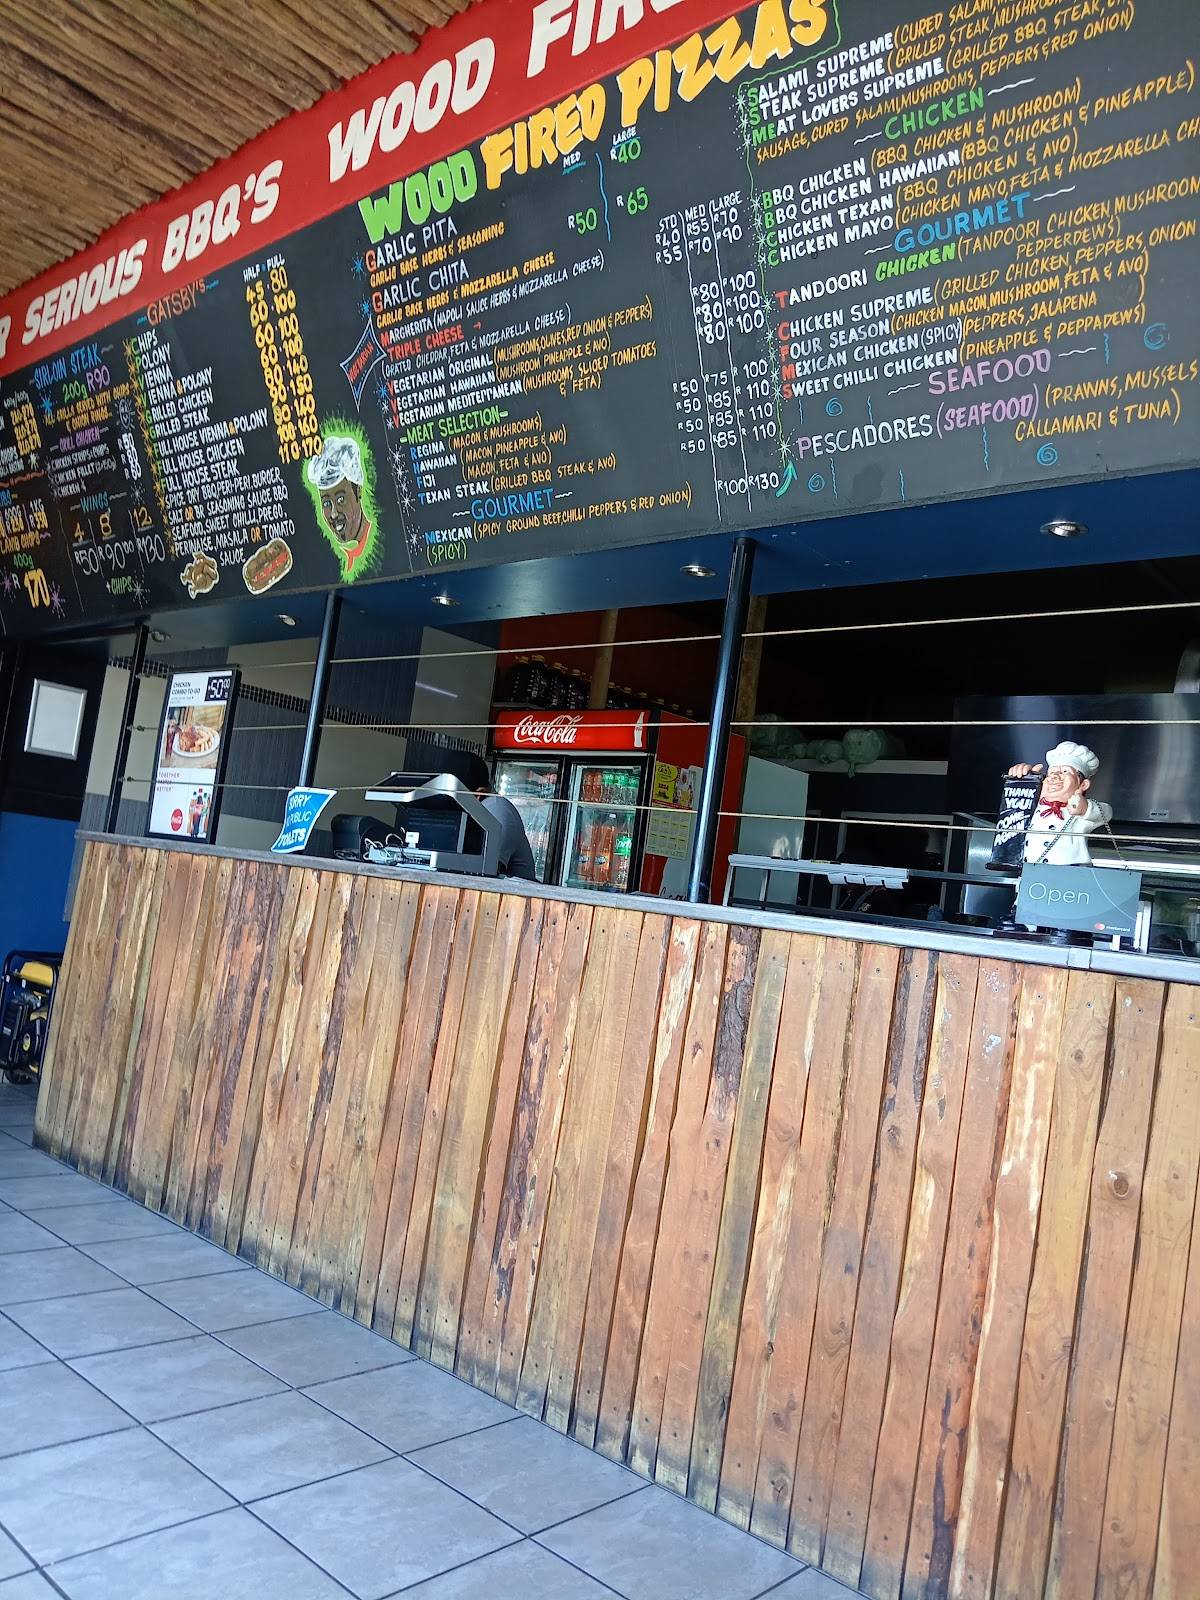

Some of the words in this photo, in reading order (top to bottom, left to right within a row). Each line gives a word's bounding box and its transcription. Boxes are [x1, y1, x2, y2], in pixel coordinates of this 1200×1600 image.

[747, 67, 809, 106] SALAMI
[816, 32, 893, 78] SUPREME
[752, 114, 797, 146] MEAT
[802, 91, 859, 127] LOVERS
[864, 57, 944, 101] SUPREME
[1014, 17, 1047, 43] BBQ
[980, 45, 1038, 80] PEPPERS
[749, 89, 802, 126] STEAK
[807, 57, 886, 103] SUPREME
[358, 149, 478, 245] WOOD
[480, 83, 606, 190] FIRED
[618, 0, 827, 127] PIZZAS
[884, 87, 984, 141] CHICKEN
[563, 151, 581, 168] MED
[612, 126, 637, 145] LARGE
[762, 184, 794, 210] BBQ
[799, 157, 866, 196] CHICKEN
[914, 120, 971, 157] CHICKEN
[991, 76, 1082, 130] MUSHROOM)
[764, 203, 798, 230] BBQ
[801, 177, 872, 215] CHICKEN
[879, 149, 960, 190] HAWAIIAN
[1003, 110, 1073, 149] CHICKEN
[1094, 59, 1195, 118] PINEAPPLE)
[21, 238, 148, 346] SERIOUS
[161, 159, 284, 274] BBQ'S
[326, 37, 495, 184] WOOD
[660, 214, 677, 232] STD
[685, 204, 706, 222] MED
[712, 190, 743, 212] LARGE
[766, 213, 833, 247] CHICKEN
[838, 193, 893, 224] TEXAN
[947, 152, 1017, 188] CHICKEN
[768, 232, 838, 266] CHICKEN
[844, 214, 893, 244] MAYO
[1069, 129, 1171, 173] MOZZARELLA
[567, 207, 598, 234] R50
[686, 218, 709, 237] R55
[894, 191, 1030, 253] GOURMET
[365, 232, 416, 272] GARLIC
[422, 216, 458, 247] PITA
[370, 266, 397, 288] GARLIC
[400, 257, 419, 277] BASE
[457, 221, 505, 253] SEASONING
[688, 236, 712, 255] R70
[243, 263, 261, 283] HALF
[372, 277, 422, 313] GARLIC
[428, 258, 469, 291] CHITA
[377, 314, 403, 329] GARLIC
[405, 302, 424, 317] BASE
[426, 295, 449, 313] HERBS
[461, 266, 519, 299] MOZZARELLA
[523, 251, 555, 276] CHEESE
[692, 282, 719, 302] R80
[775, 268, 868, 308] TANDOORI
[875, 242, 956, 281] CHICKEN
[777, 309, 844, 341] CHICKEN
[851, 286, 933, 323] SUPREME
[1149, 219, 1196, 247] ONION
[147, 278, 206, 326] GATSBY'S
[379, 319, 433, 348] MARGHERITA
[466, 297, 488, 316] SAUCE
[695, 302, 722, 323] R80
[726, 290, 760, 311] R100
[131, 328, 158, 356] CHIPS
[387, 339, 422, 362] TRIPLE
[425, 323, 464, 351] CHEESE
[479, 321, 531, 349] MOZZARELLA
[830, 319, 890, 349] SEASON
[34, 357, 67, 390] SIRLOIN
[70, 343, 102, 375] STEAK
[135, 342, 171, 373] POLONY
[137, 364, 174, 391] VIENNA
[387, 370, 445, 397] VEGETARIAN
[448, 353, 494, 377] ORIGINAL
[782, 350, 847, 381] MEXICAN
[853, 332, 918, 362] CHICKEN
[782, 377, 831, 400] SWEET
[833, 367, 879, 389] CHILLI
[883, 347, 958, 377] CHICKEN
[928, 348, 1052, 395] SEAFOOD
[86, 364, 111, 393] R90
[390, 386, 446, 414] VEGETARIAN
[450, 370, 496, 395] HAWAIIAN
[543, 344, 583, 367] PINEAPPLE
[392, 404, 445, 429] VEGETARIAN
[578, 353, 609, 376] SLICED
[611, 341, 657, 366] TOMATOES
[145, 400, 177, 425] GRILLED
[177, 387, 214, 412] CHICKEN
[149, 415, 181, 439] GRILLED
[183, 406, 211, 428] STEAK
[798, 413, 934, 459] PESCADORES
[936, 383, 1040, 440] (SEAFOOD)
[1015, 410, 1102, 443] CALLAMARI
[1124, 388, 1182, 426] TUNA)
[206, 437, 246, 461] CHICKEN
[210, 458, 240, 479] STEAK
[410, 440, 445, 460] REGINA
[413, 454, 457, 474] HAWAIIAN
[80, 491, 109, 513] WINGS
[416, 474, 436, 489] FIJI
[418, 489, 450, 505] TEXAN
[455, 481, 490, 498] STEAK
[531, 469, 552, 483] BBQ
[557, 463, 586, 479] STEAK
[99, 511, 112, 537] 8
[206, 494, 246, 517] SEASONING
[247, 490, 272, 508] SAUCE
[425, 526, 472, 545] MEXICAN
[506, 515, 540, 533] GROUND
[588, 499, 627, 518] PEPPERS
[471, 488, 554, 521] GOURMET
[262, 519, 295, 541] TOMATO
[425, 539, 467, 561] (SPICY)
[219, 548, 246, 567] SAUCE
[111, 576, 133, 595] CHIPS
[1004, 787, 1037, 799] THANK
[1028, 882, 1090, 906] Open
